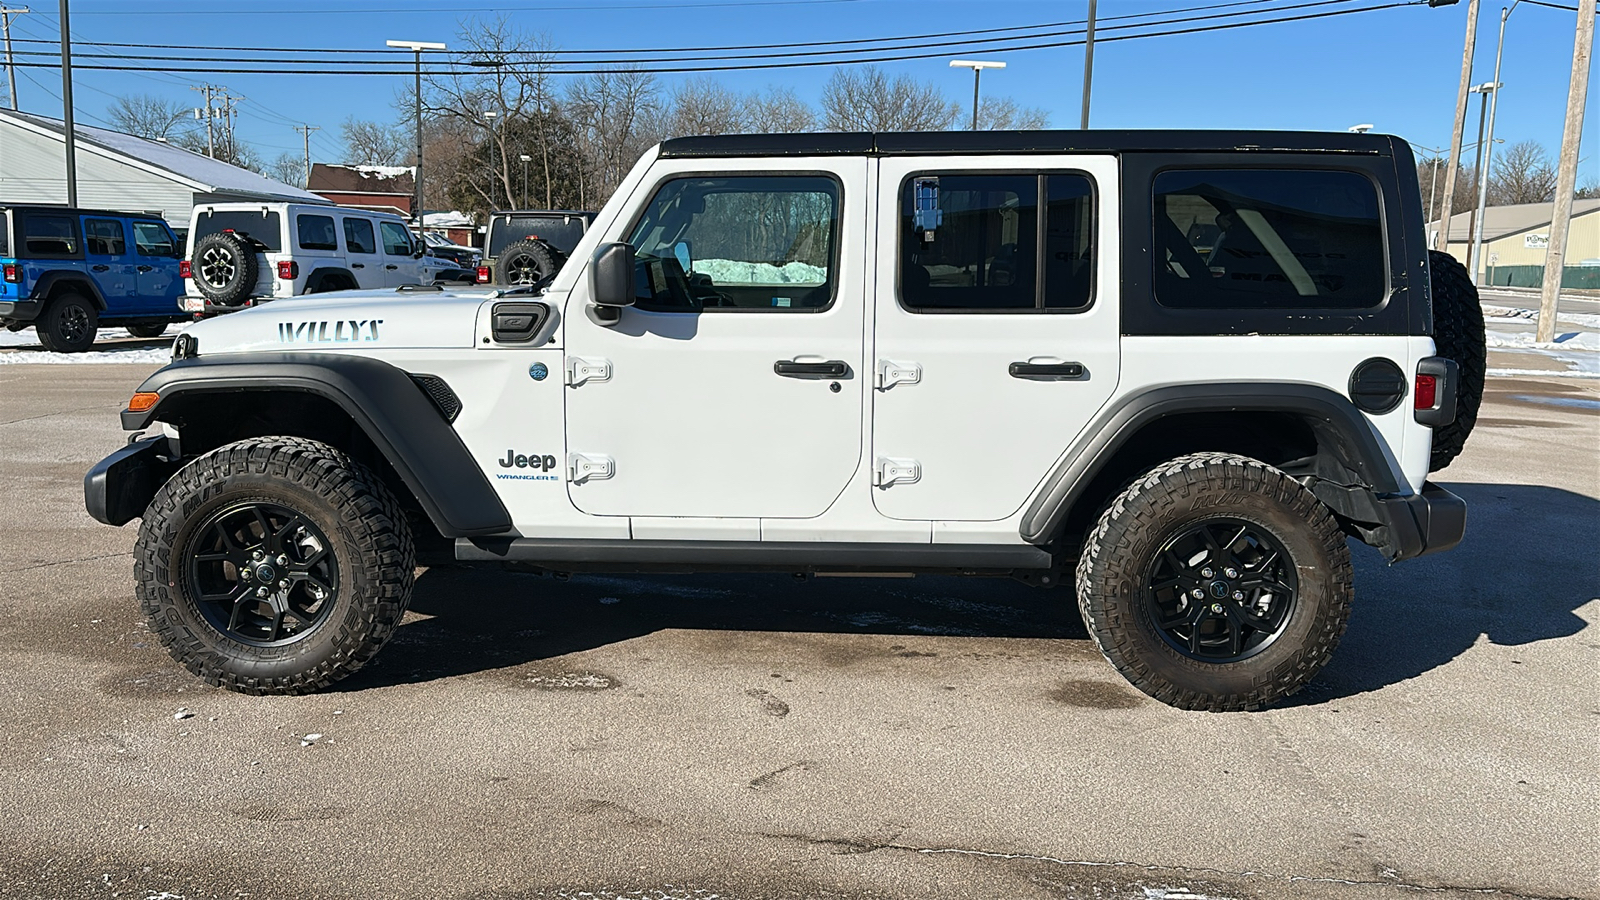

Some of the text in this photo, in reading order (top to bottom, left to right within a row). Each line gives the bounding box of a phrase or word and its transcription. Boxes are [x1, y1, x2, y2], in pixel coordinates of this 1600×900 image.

[278, 319, 384, 342] WILLYS
[498, 449, 557, 473] Jeep
[496, 473, 549, 481] WRANGLER
[1189, 491, 1252, 513] M/T
[156, 479, 229, 667] WILDPEAK M/T
